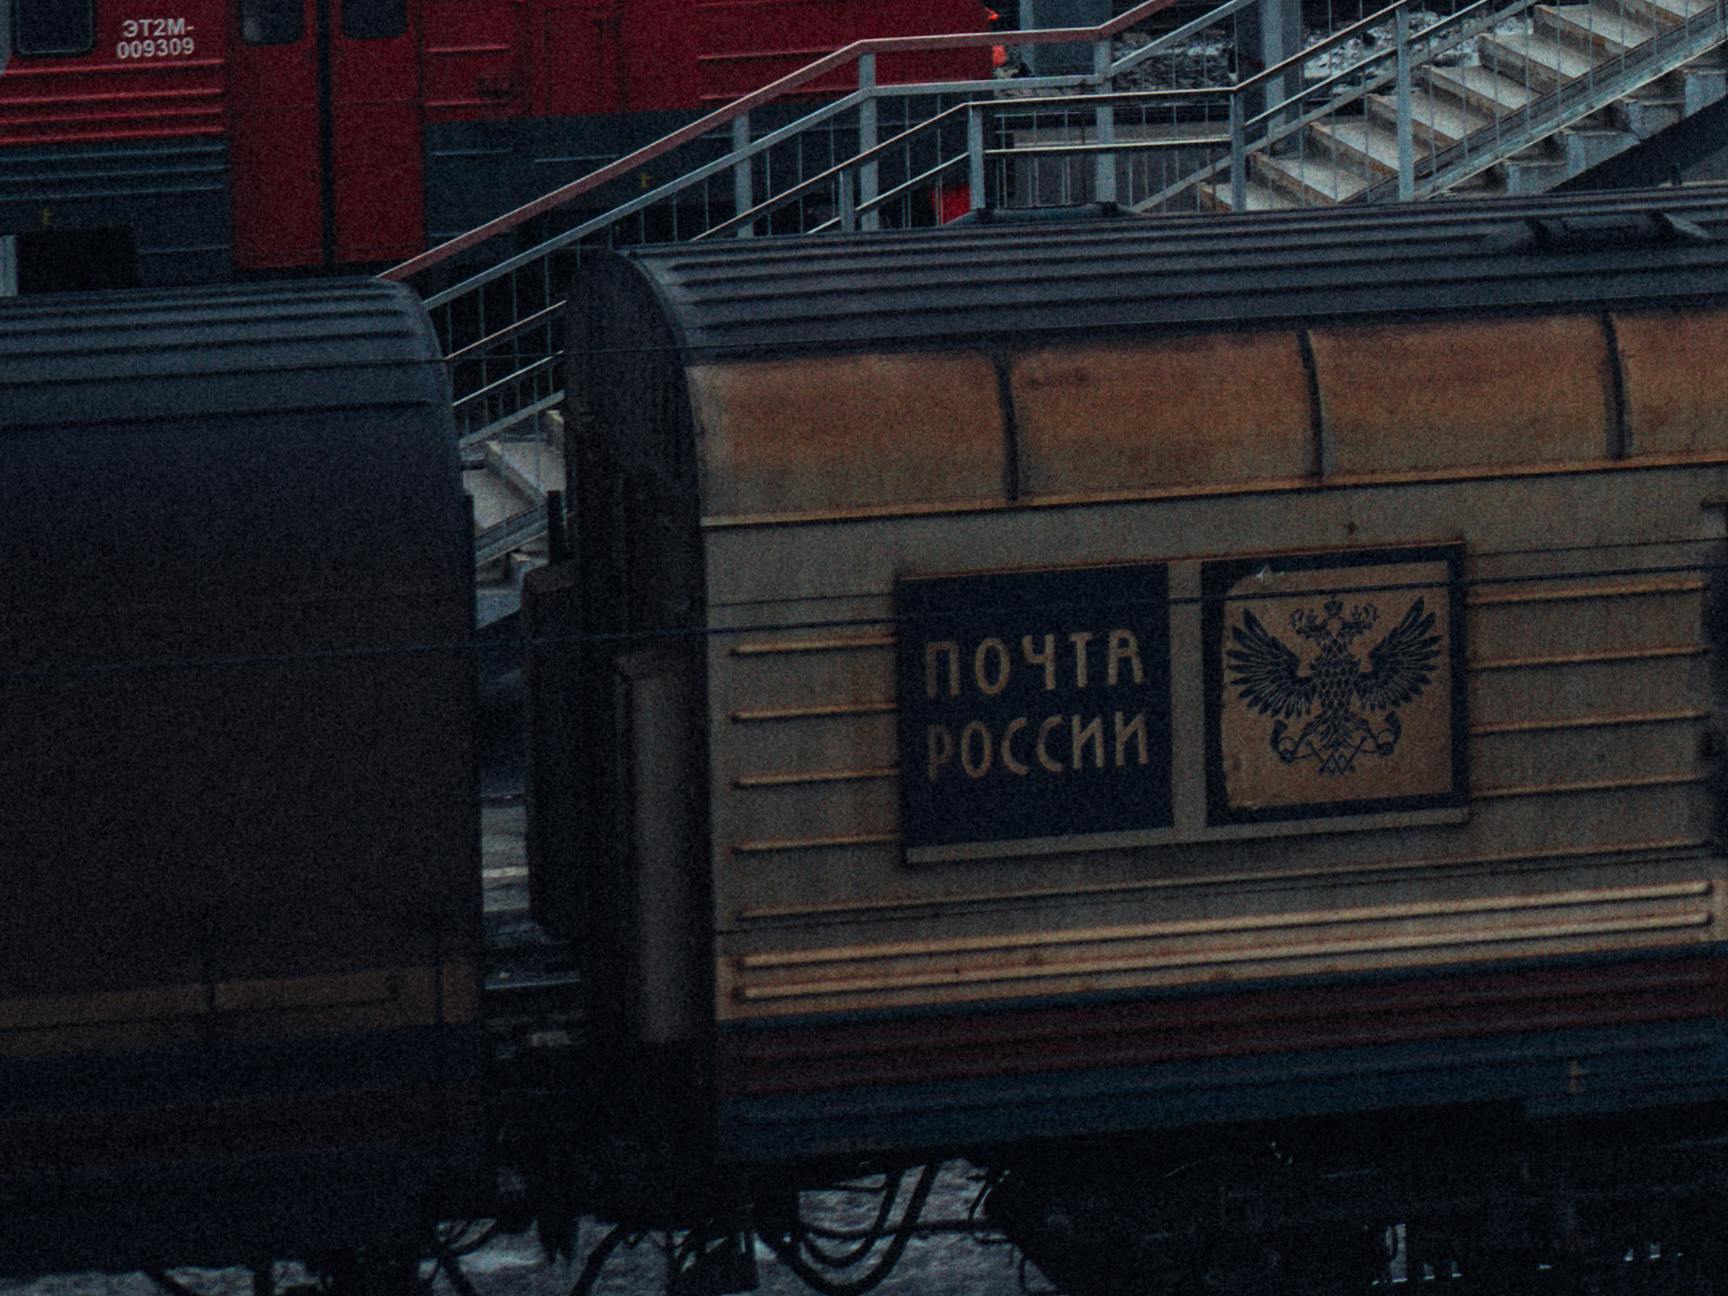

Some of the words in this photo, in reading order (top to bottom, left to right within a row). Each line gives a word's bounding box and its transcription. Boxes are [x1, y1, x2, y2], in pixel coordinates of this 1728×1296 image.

[116, 36, 195, 60] 009309
[122, 17, 195, 38] ЭТ2М-
[924, 627, 1146, 700] ПОЧТА
[926, 713, 1149, 782] РОССИИ
